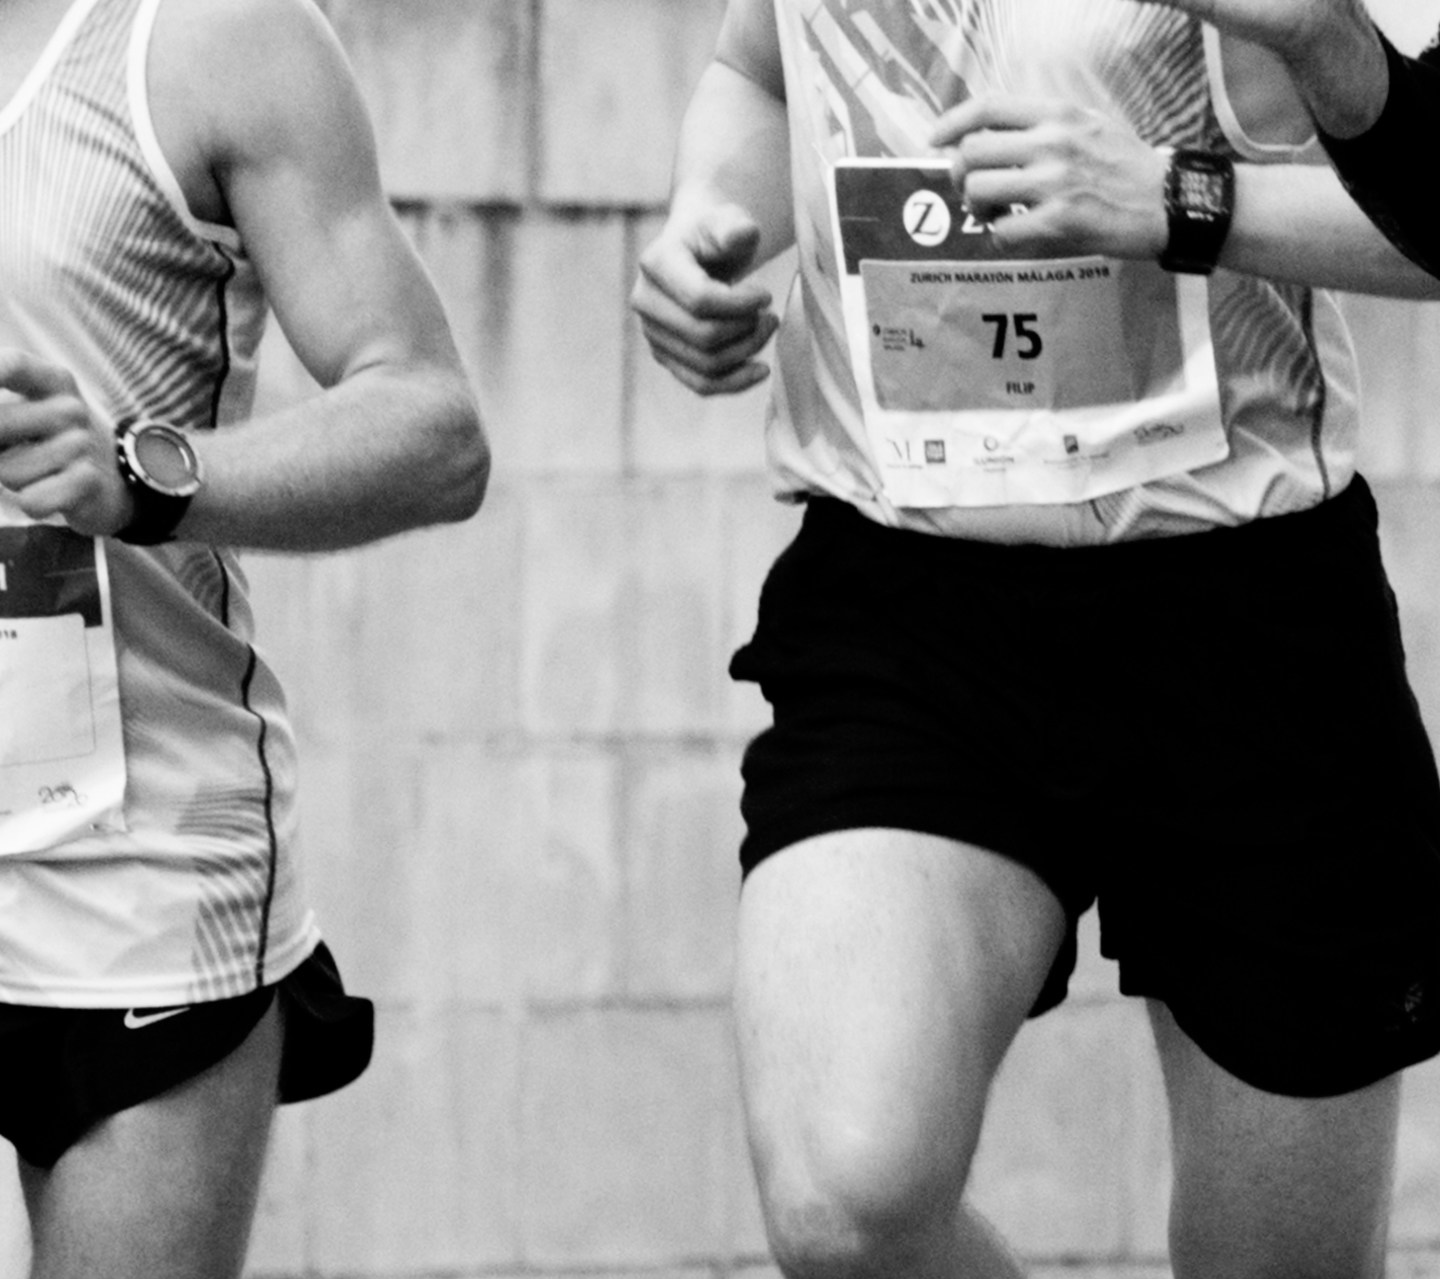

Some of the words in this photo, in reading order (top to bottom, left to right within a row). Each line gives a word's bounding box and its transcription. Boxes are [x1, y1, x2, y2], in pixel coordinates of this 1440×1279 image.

[910, 270, 952, 285] ZURICH
[1017, 267, 1075, 283] MÁLAGA
[1078, 265, 1110, 280] 2018
[981, 313, 1043, 360] 75
[1006, 380, 1036, 395] FILIP
